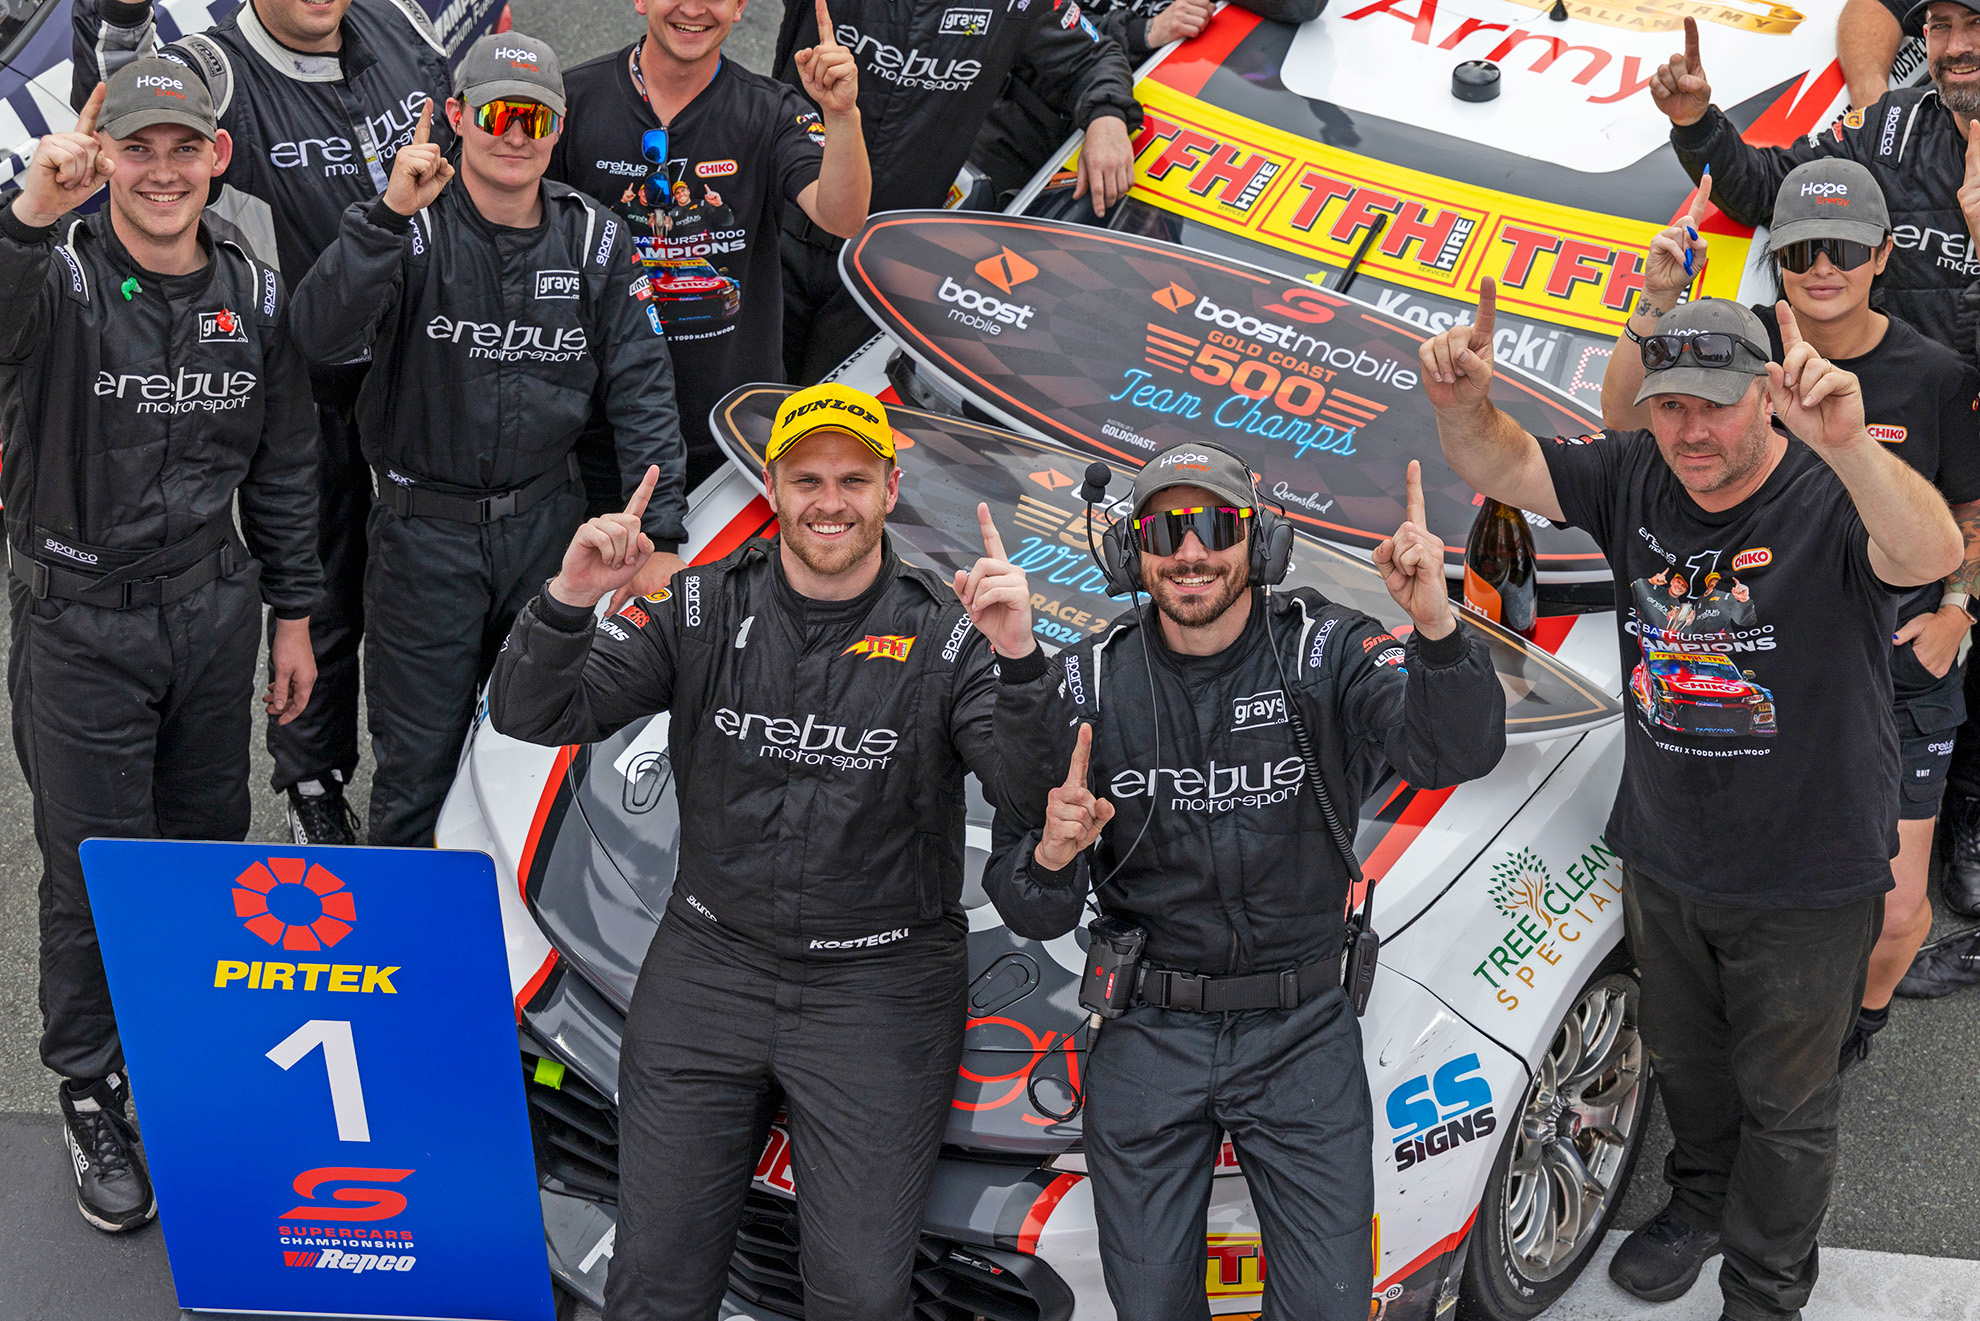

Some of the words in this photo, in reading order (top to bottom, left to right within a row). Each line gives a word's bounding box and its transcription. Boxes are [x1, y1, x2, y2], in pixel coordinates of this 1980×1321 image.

[1667, 2, 1775, 29] ARMY
[446, 17, 473, 59] emium
[836, 24, 982, 80] erebus
[495, 47, 537, 63] Hope
[511, 60, 540, 73] Energy
[1889, 38, 1928, 85] KOSTEC
[137, 74, 183, 91] Hope
[867, 62, 973, 92] motorsport
[155, 88, 187, 101] Energy
[1879, 106, 1902, 156] sparco
[596, 160, 648, 174] erebus
[697, 163, 735, 175] CHIKO
[1131, 112, 1270, 206] TFH
[1234, 163, 1281, 212] HIRE
[1800, 181, 1848, 198] Hope
[1816, 196, 1850, 208] Energy
[1289, 170, 1462, 266] TFH
[1437, 218, 1476, 271] HIRE
[596, 220, 617, 267] sparco
[632, 233, 708, 246] BATHURST
[710, 229, 746, 241] 1000
[636, 239, 746, 259] AMPIONS
[54, 245, 82, 293] sparco
[1418, 265, 1452, 280] SERVICES
[263, 269, 277, 317] sparco
[540, 276, 580, 294] grays
[938, 277, 1034, 330] boost
[426, 315, 588, 351] erebus
[694, 325, 736, 339] HAZELWOOD
[948, 308, 1002, 336] mobile
[1374, 289, 1560, 372] Kostcki
[469, 346, 588, 362] motorsport
[1207, 329, 1264, 358] GOLD
[1267, 349, 1337, 384] COAST
[94, 367, 258, 400] erebus
[1190, 345, 1327, 417] 500
[136, 395, 251, 414] motorsport
[781, 398, 881, 430] DUNLOP
[1109, 368, 1203, 420] Team
[1213, 395, 1358, 459] Champs
[1867, 426, 1905, 440] CHIKO
[1160, 453, 1208, 469] Hope
[1176, 463, 1211, 474] Energy
[1272, 481, 1335, 514] Queensland
[43, 538, 99, 565] sparco
[1734, 550, 1769, 567] CHIKO
[685, 575, 701, 628] sparco
[1028, 592, 1087, 627] RACE
[1087, 611, 1110, 635] 2
[734, 616, 755, 649] 1
[1033, 617, 1083, 645] 2024
[1309, 618, 1339, 668] sparco
[1642, 623, 1727, 643] BATHURST
[1729, 624, 1775, 641] 1000
[865, 634, 904, 658] TFH
[1064, 654, 1086, 705] sparco
[1678, 681, 1740, 694] CHIKO
[1235, 697, 1284, 724] grays
[714, 708, 899, 757] erebus
[759, 743, 892, 771] motorsport
[1691, 748, 1714, 757] TODD
[1715, 748, 1771, 757] HAZELWOOD
[1111, 756, 1306, 799] erebus
[1171, 783, 1304, 814] motorsport
[1473, 914, 1548, 989] TREE
[1543, 834, 1619, 916] CLEAN
[809, 927, 909, 949] KOSTECKI
[213, 960, 402, 994] PIRTEK
[265, 1019, 371, 1143] 1
[1385, 1052, 1493, 1144] SS
[1394, 1106, 1498, 1173] SIGNS
[278, 1226, 414, 1240] SUPERCARS
[280, 1237, 415, 1250] CHAMPIONSHIP
[315, 1248, 417, 1274] Repco
